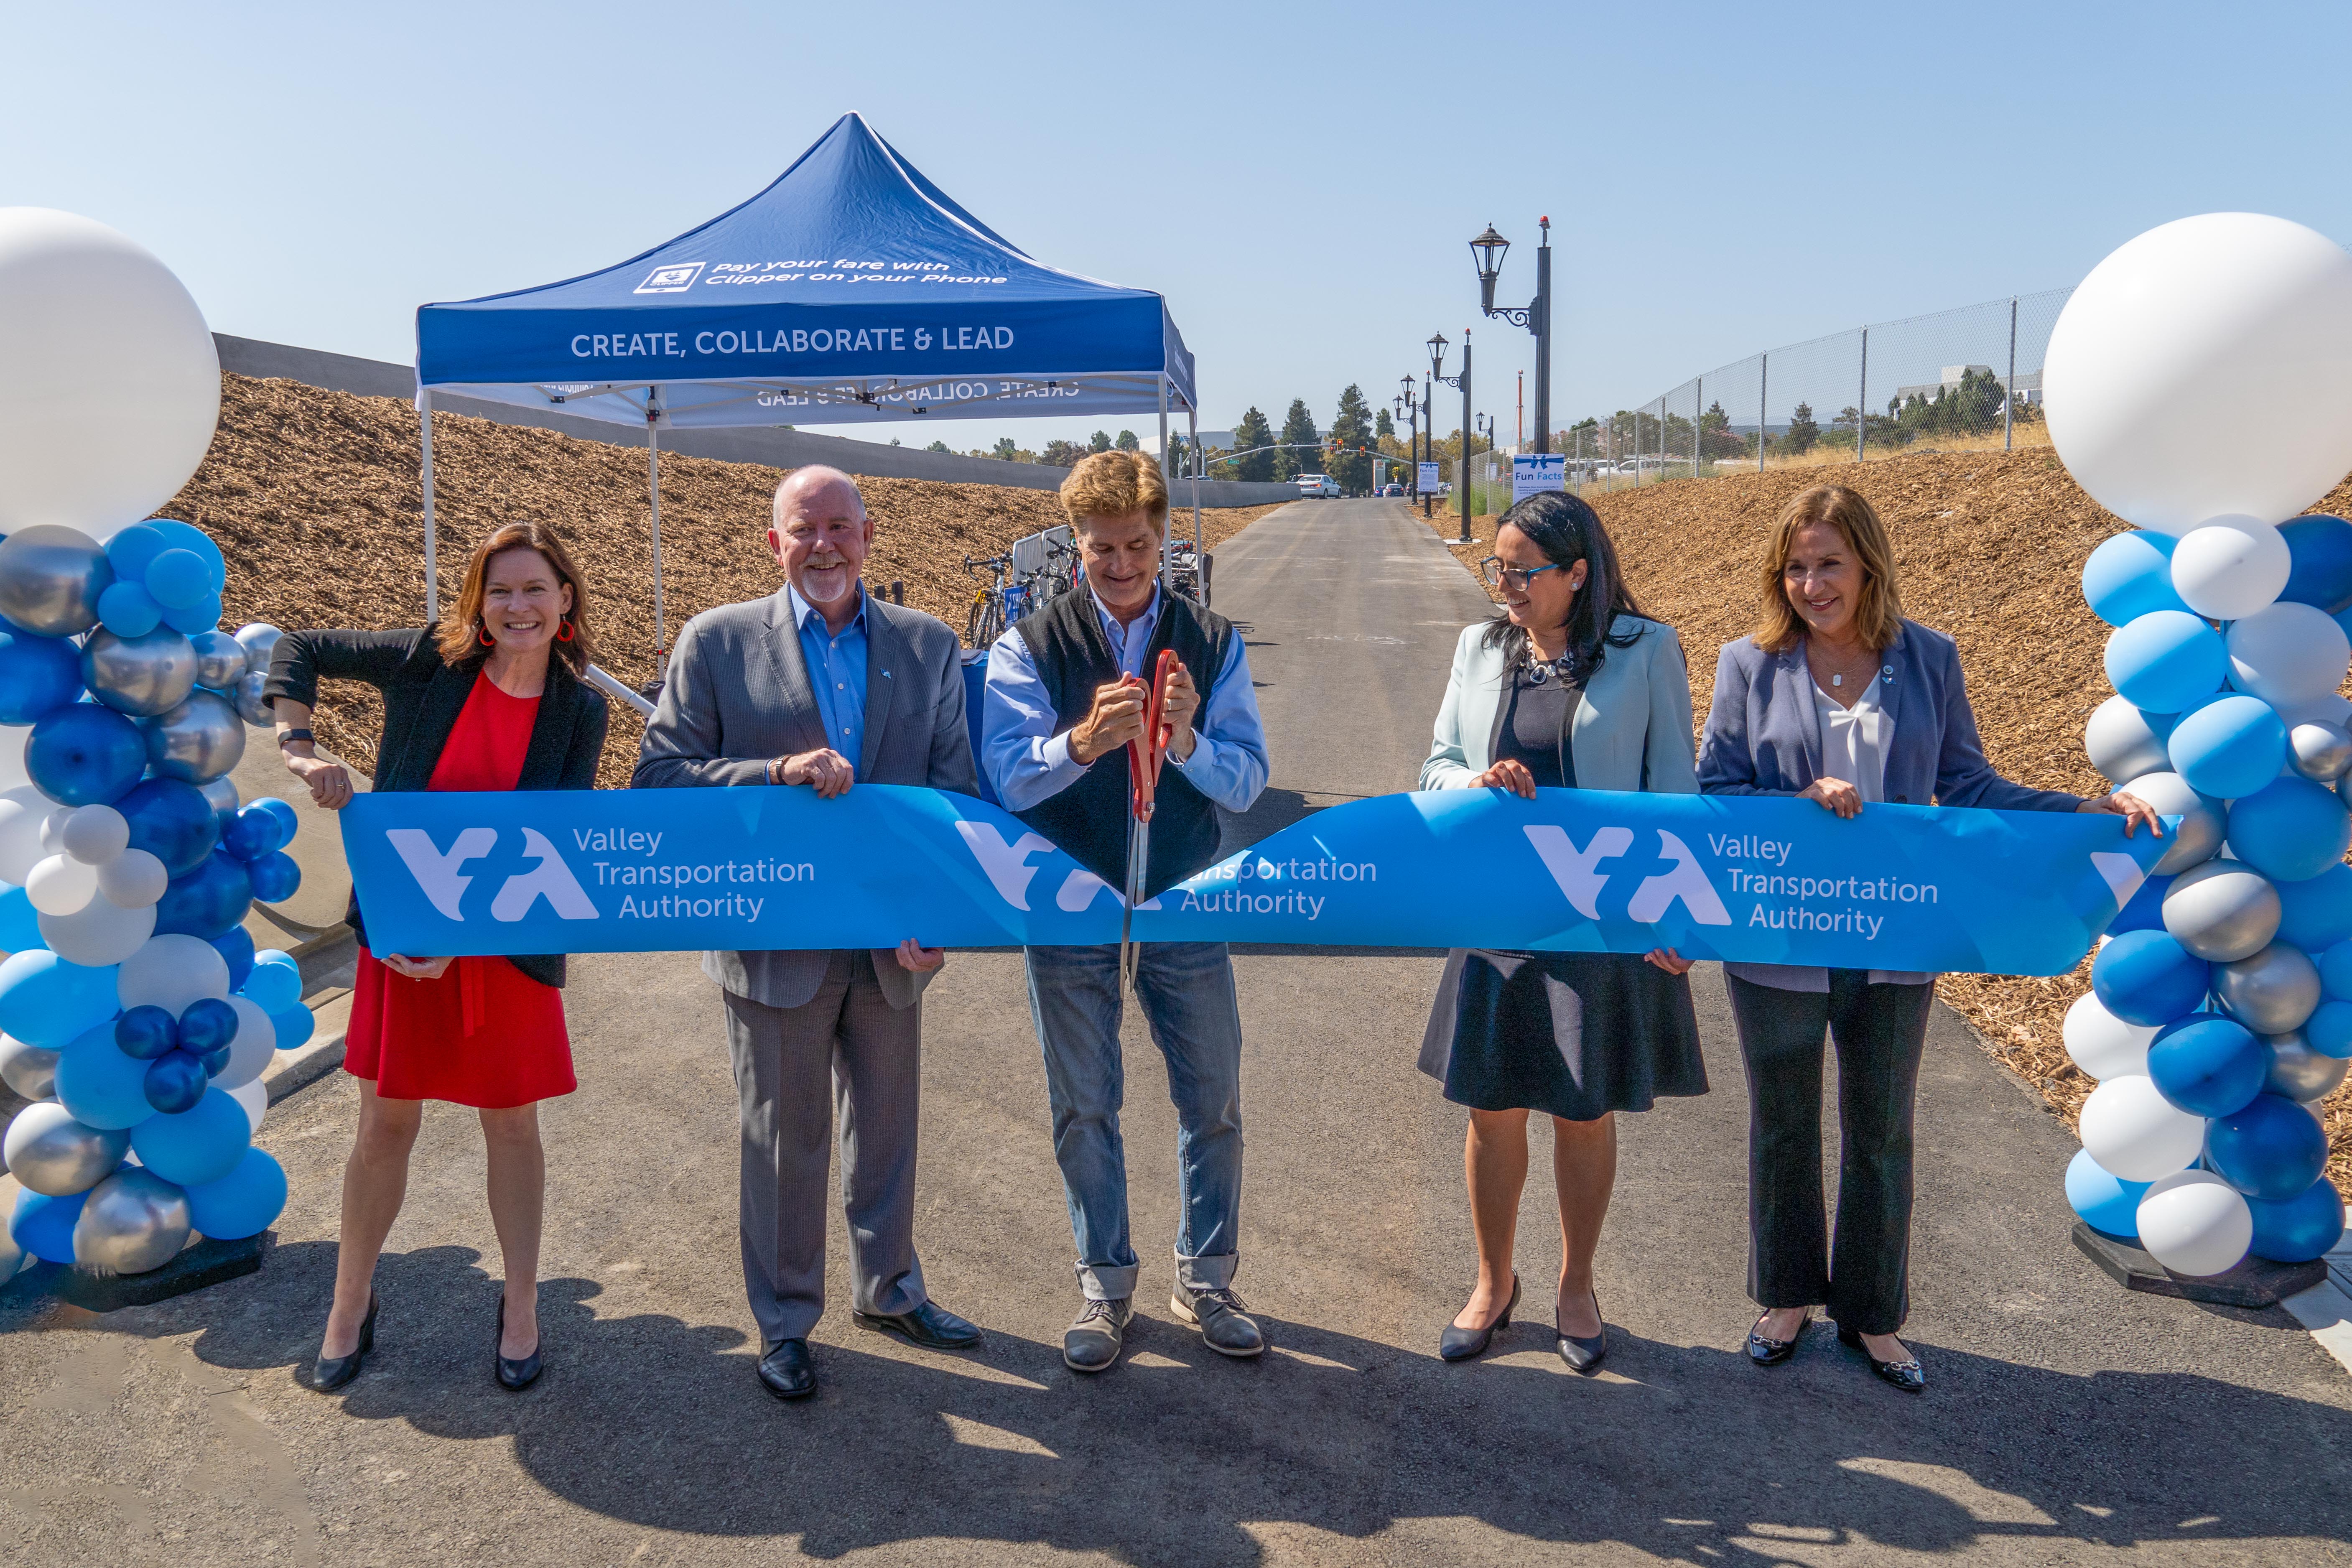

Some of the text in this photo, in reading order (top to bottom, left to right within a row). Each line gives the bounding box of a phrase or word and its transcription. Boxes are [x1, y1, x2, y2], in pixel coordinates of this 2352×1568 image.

[706, 274, 805, 285] Clipper
[920, 274, 1007, 283] Phone
[711, 259, 950, 273] Pay your fare with
[571, 327, 1014, 357] CREATE, COLLABORATE & LEAD
[573, 828, 662, 857] Valley
[1708, 834, 1791, 867] Valley
[594, 858, 813, 888] Transportation
[1189, 856, 1376, 883] ansportation
[1728, 869, 1937, 903] Transportation
[619, 892, 763, 922] Authority
[1180, 888, 1325, 920] Authority
[1749, 903, 1883, 940] Authority
